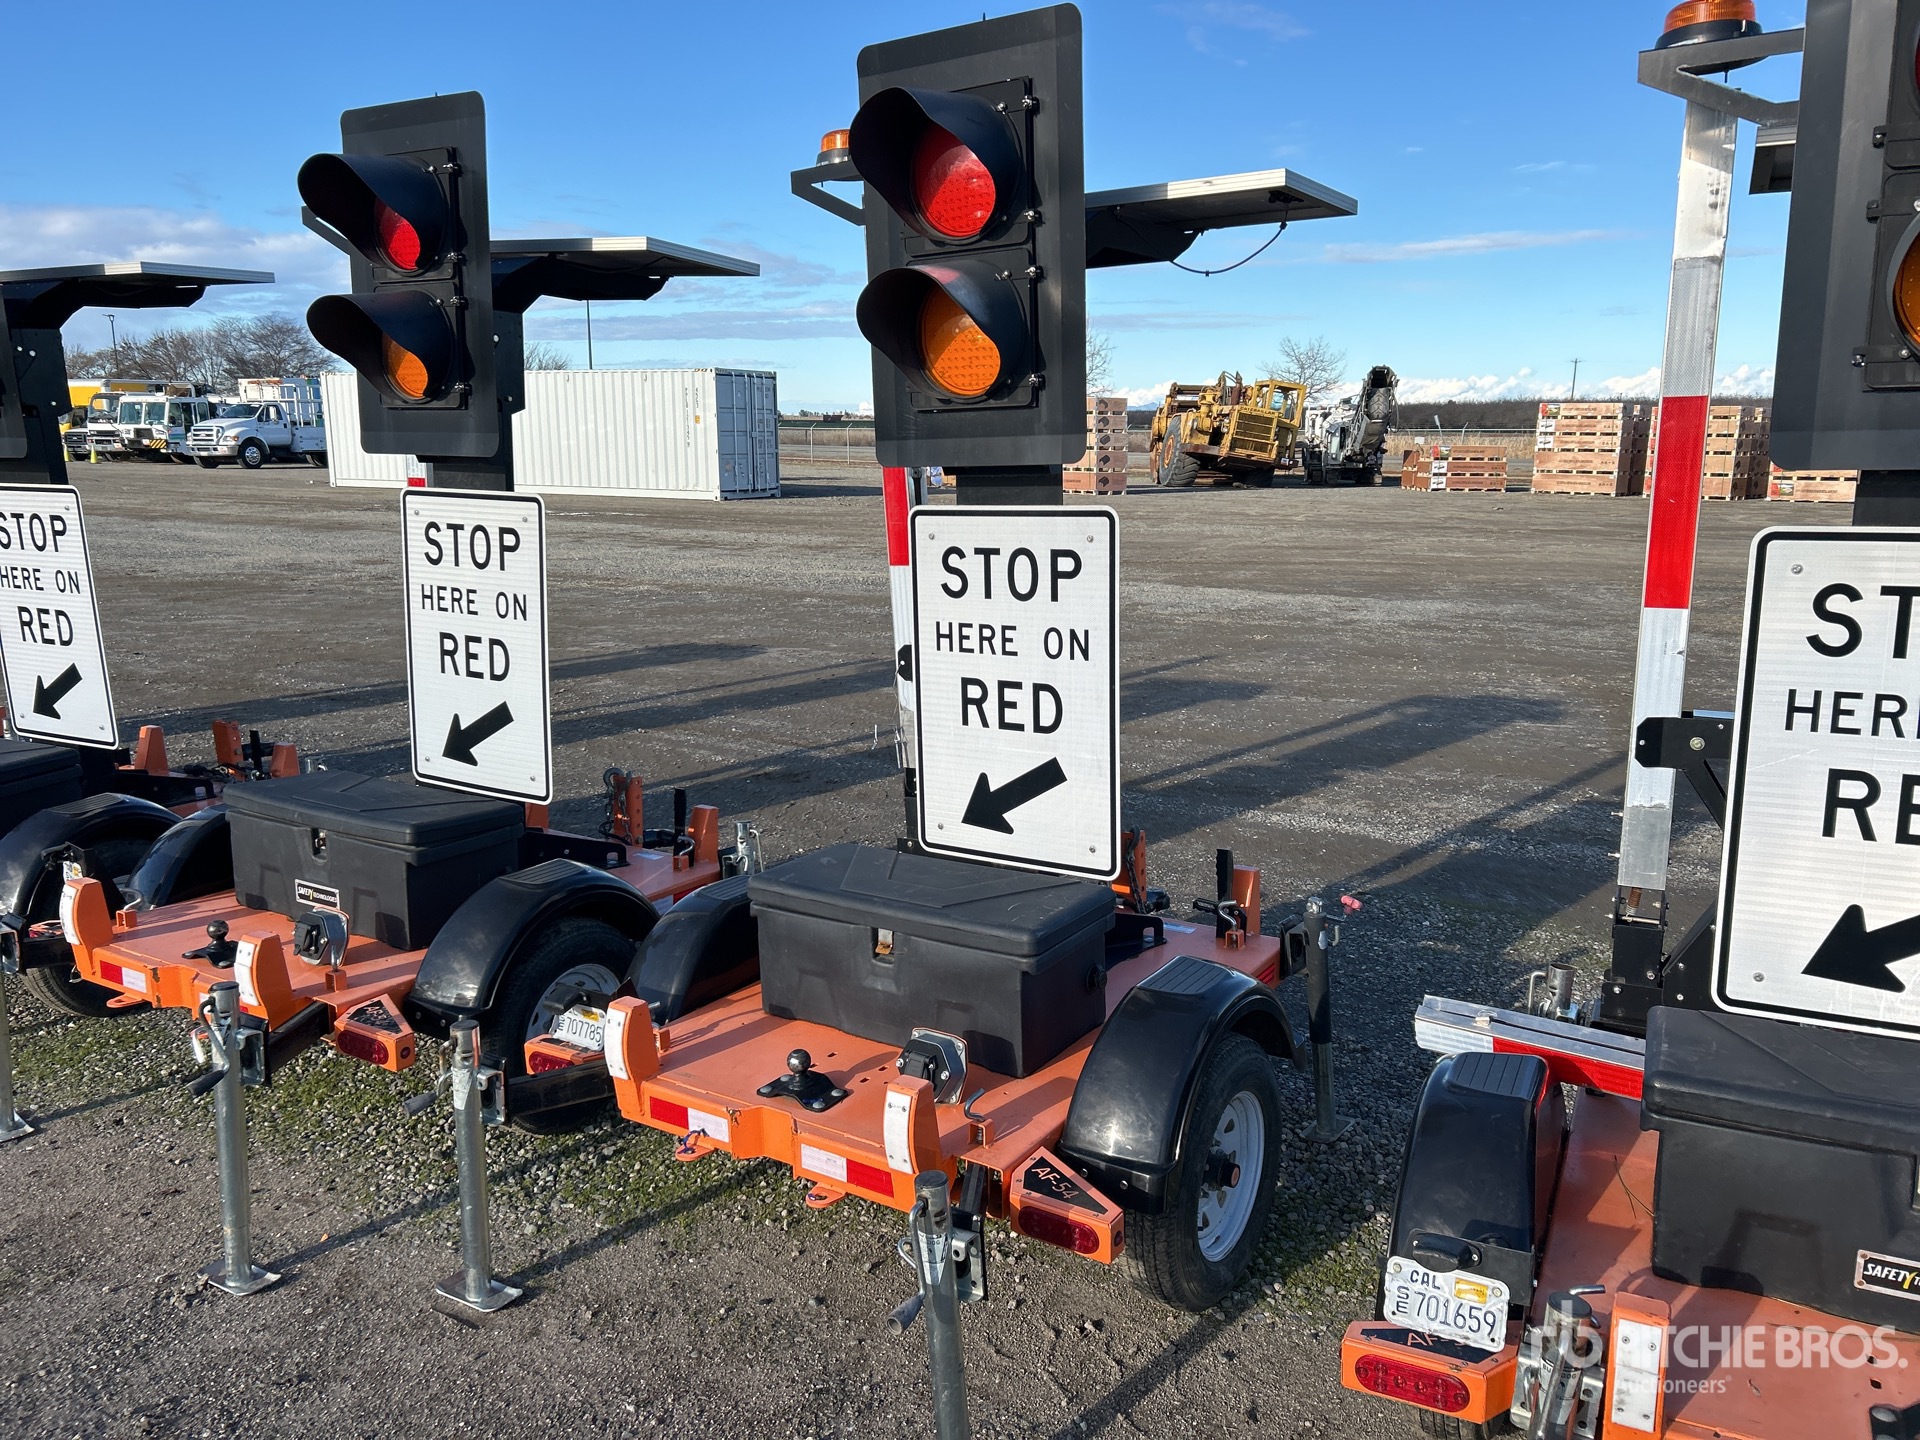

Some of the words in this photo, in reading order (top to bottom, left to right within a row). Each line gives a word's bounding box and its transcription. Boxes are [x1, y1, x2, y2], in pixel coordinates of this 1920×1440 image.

[0, 511, 67, 552] STOP
[424, 521, 521, 572] STOP
[0, 566, 44, 591] HERE
[55, 569, 80, 594] ON
[940, 546, 1082, 602] STOP
[421, 584, 478, 616] HERE
[496, 591, 527, 621] ON
[17, 606, 73, 646] RED
[935, 621, 1018, 656] HERE
[1044, 627, 1089, 661] ON
[439, 632, 510, 682] RED
[961, 677, 1063, 734] RED
[1784, 689, 1920, 739] HER
[566, 1017, 602, 1043] 707785
[1031, 1167, 1079, 1199] AF-54
[1409, 1269, 1441, 1290] CAL
[1863, 1263, 1919, 1290] SAFETY
[1414, 1290, 1497, 1337] 701659
